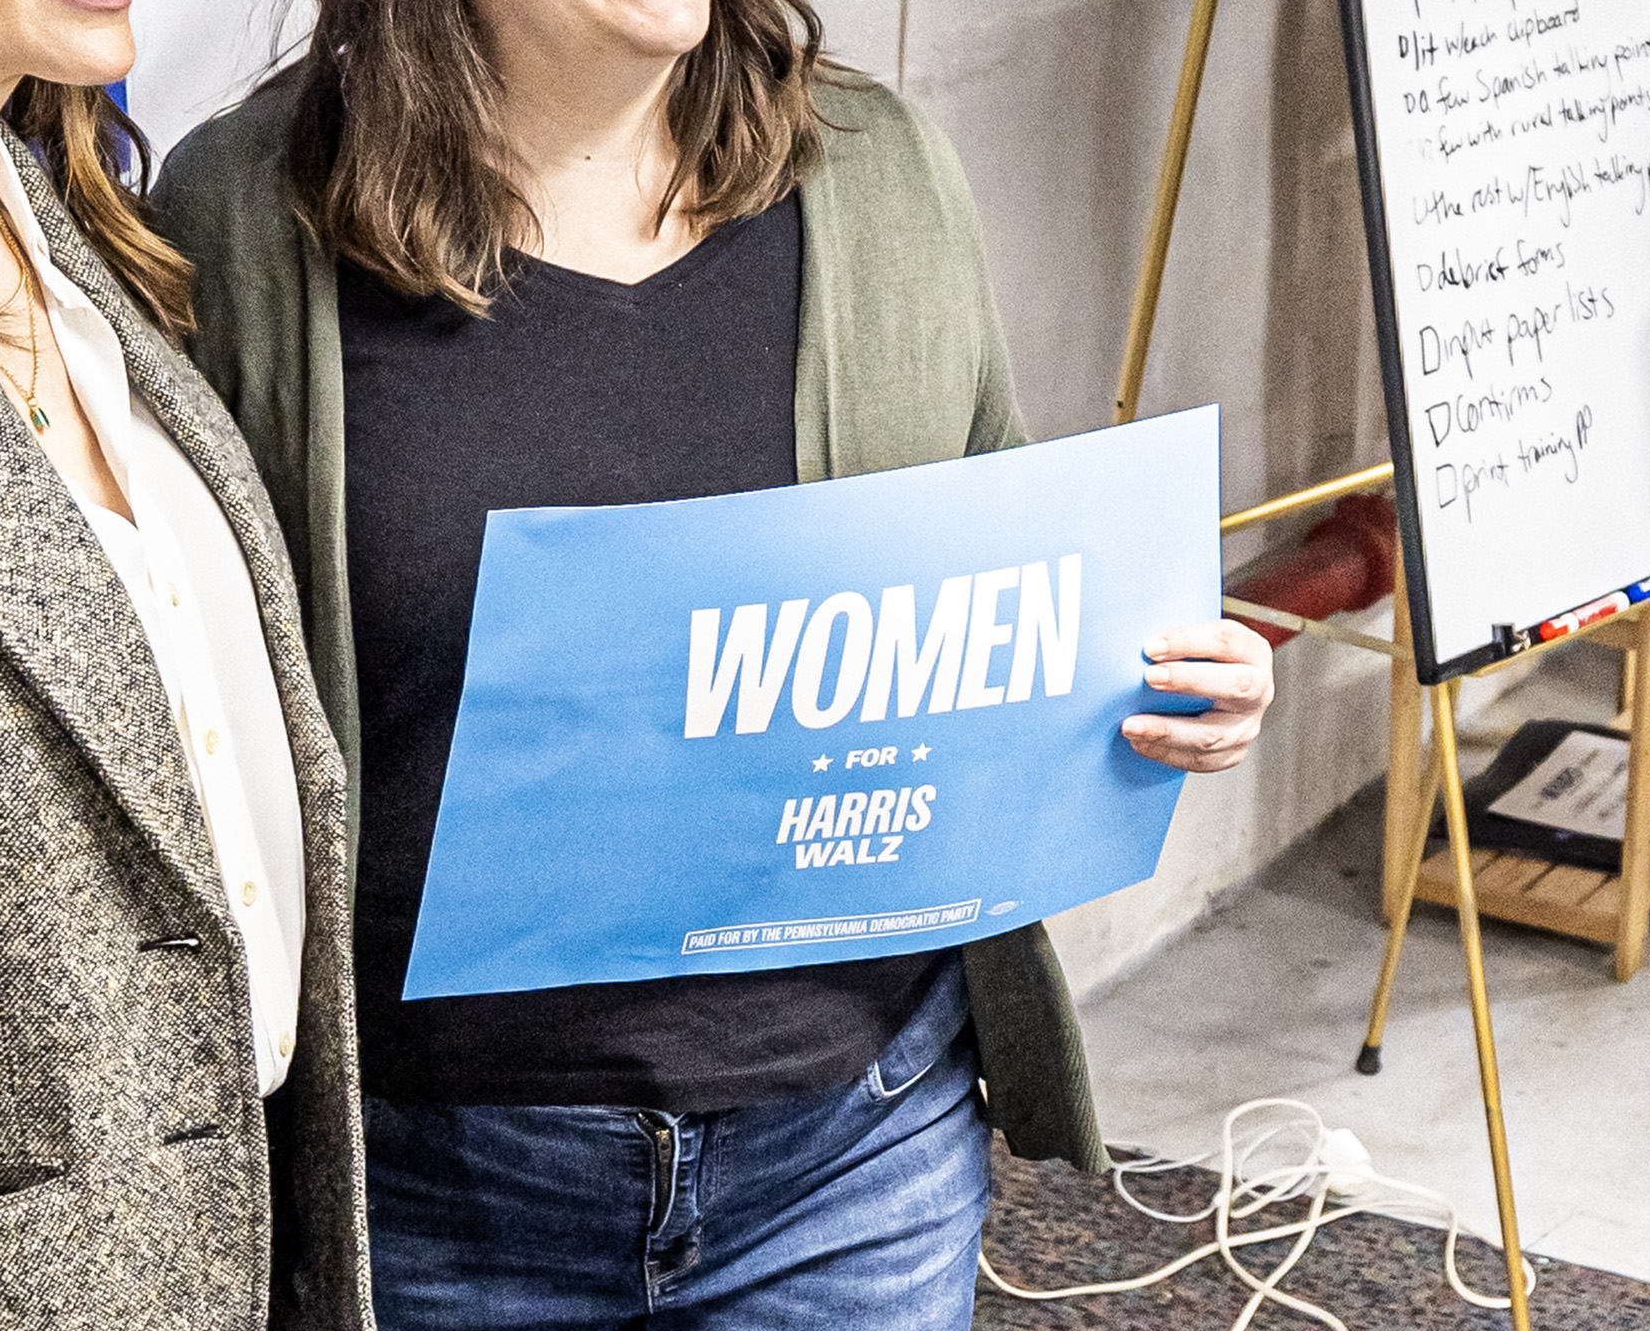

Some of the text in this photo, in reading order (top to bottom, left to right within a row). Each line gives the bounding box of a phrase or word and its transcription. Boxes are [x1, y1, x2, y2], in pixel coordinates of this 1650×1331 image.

[1475, 59, 1548, 109] Spanish
[1507, 304, 1562, 367] paper
[684, 554, 1082, 739] WOMEN
[846, 747, 898, 770] FOR
[777, 785, 936, 844] HARRIS
[795, 836, 903, 869] WALZ
[689, 904, 976, 949] PAID FOR BY THE PENNSYLVANIA DEMOCRATIC PARTY
